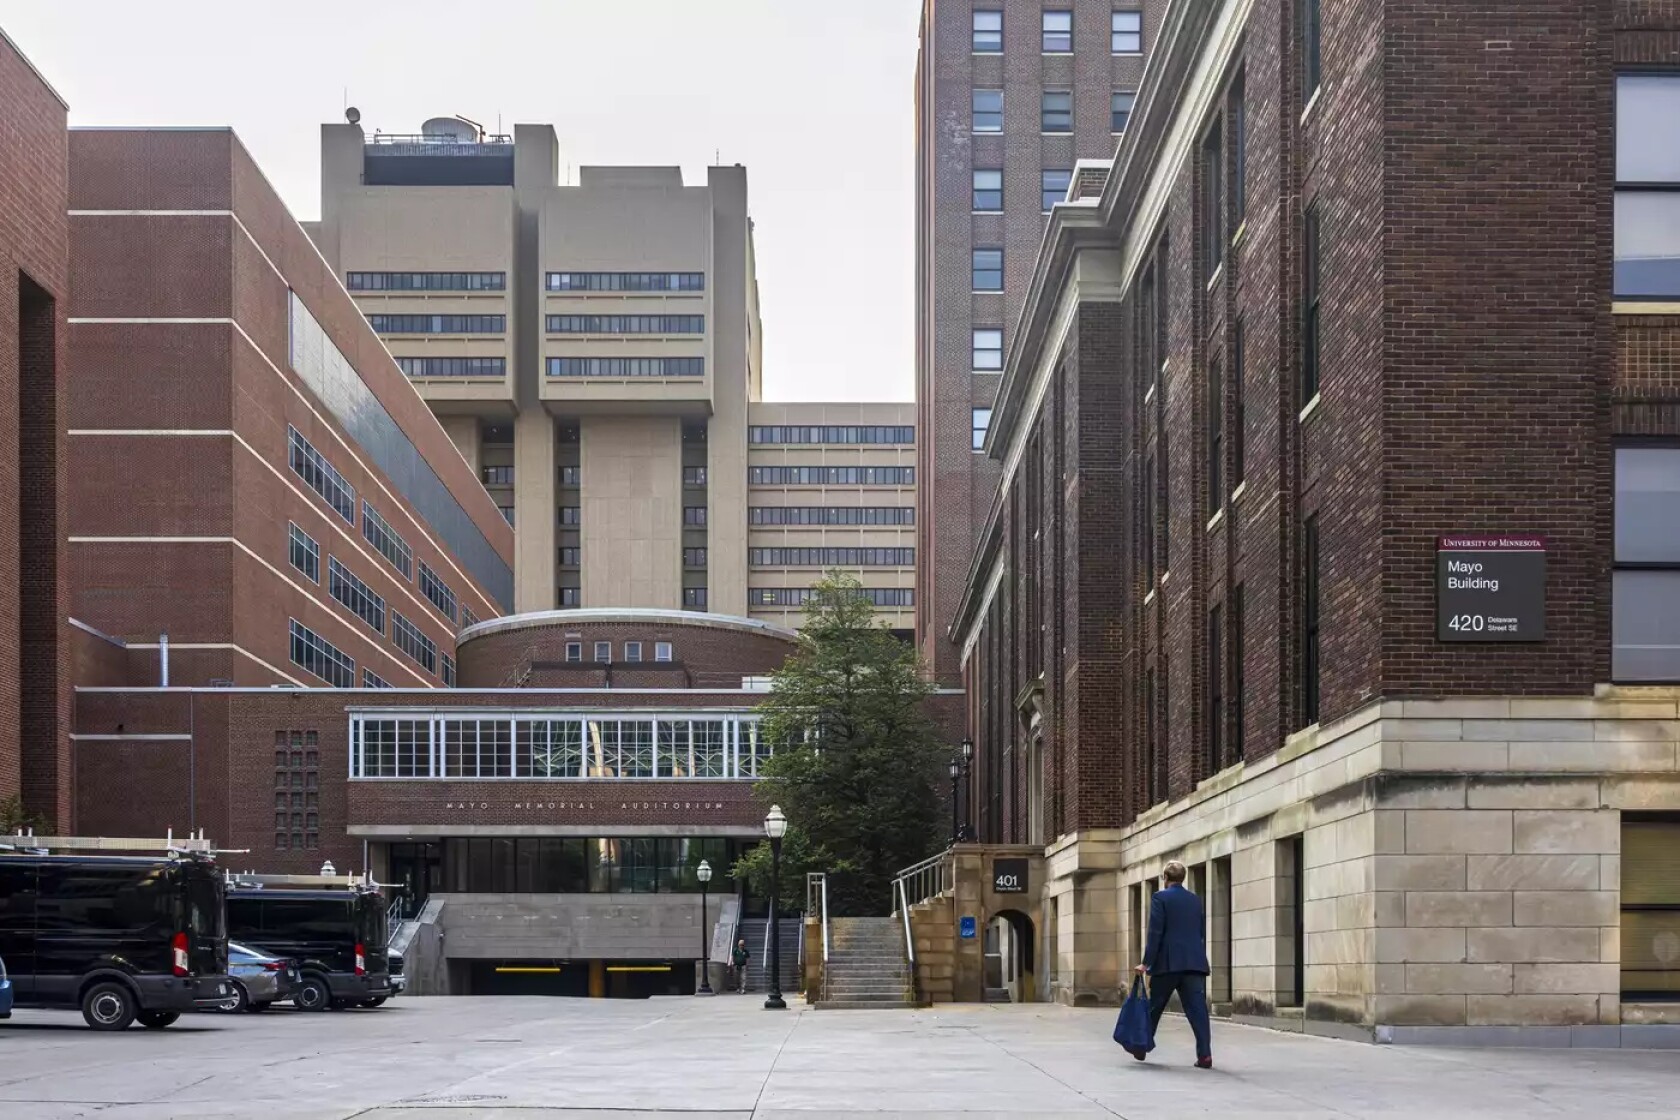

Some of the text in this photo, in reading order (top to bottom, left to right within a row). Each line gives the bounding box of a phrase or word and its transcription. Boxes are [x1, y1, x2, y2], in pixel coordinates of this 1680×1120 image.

[1443, 538, 1486, 547] UNIVERSITY
[1499, 538, 1542, 547] MINNESOTA
[1448, 560, 1483, 575] Mayo
[1447, 577, 1499, 592] Building
[1448, 614, 1484, 631] 420
[1487, 624, 1518, 632] Street SE
[996, 874, 1017, 886] 401
